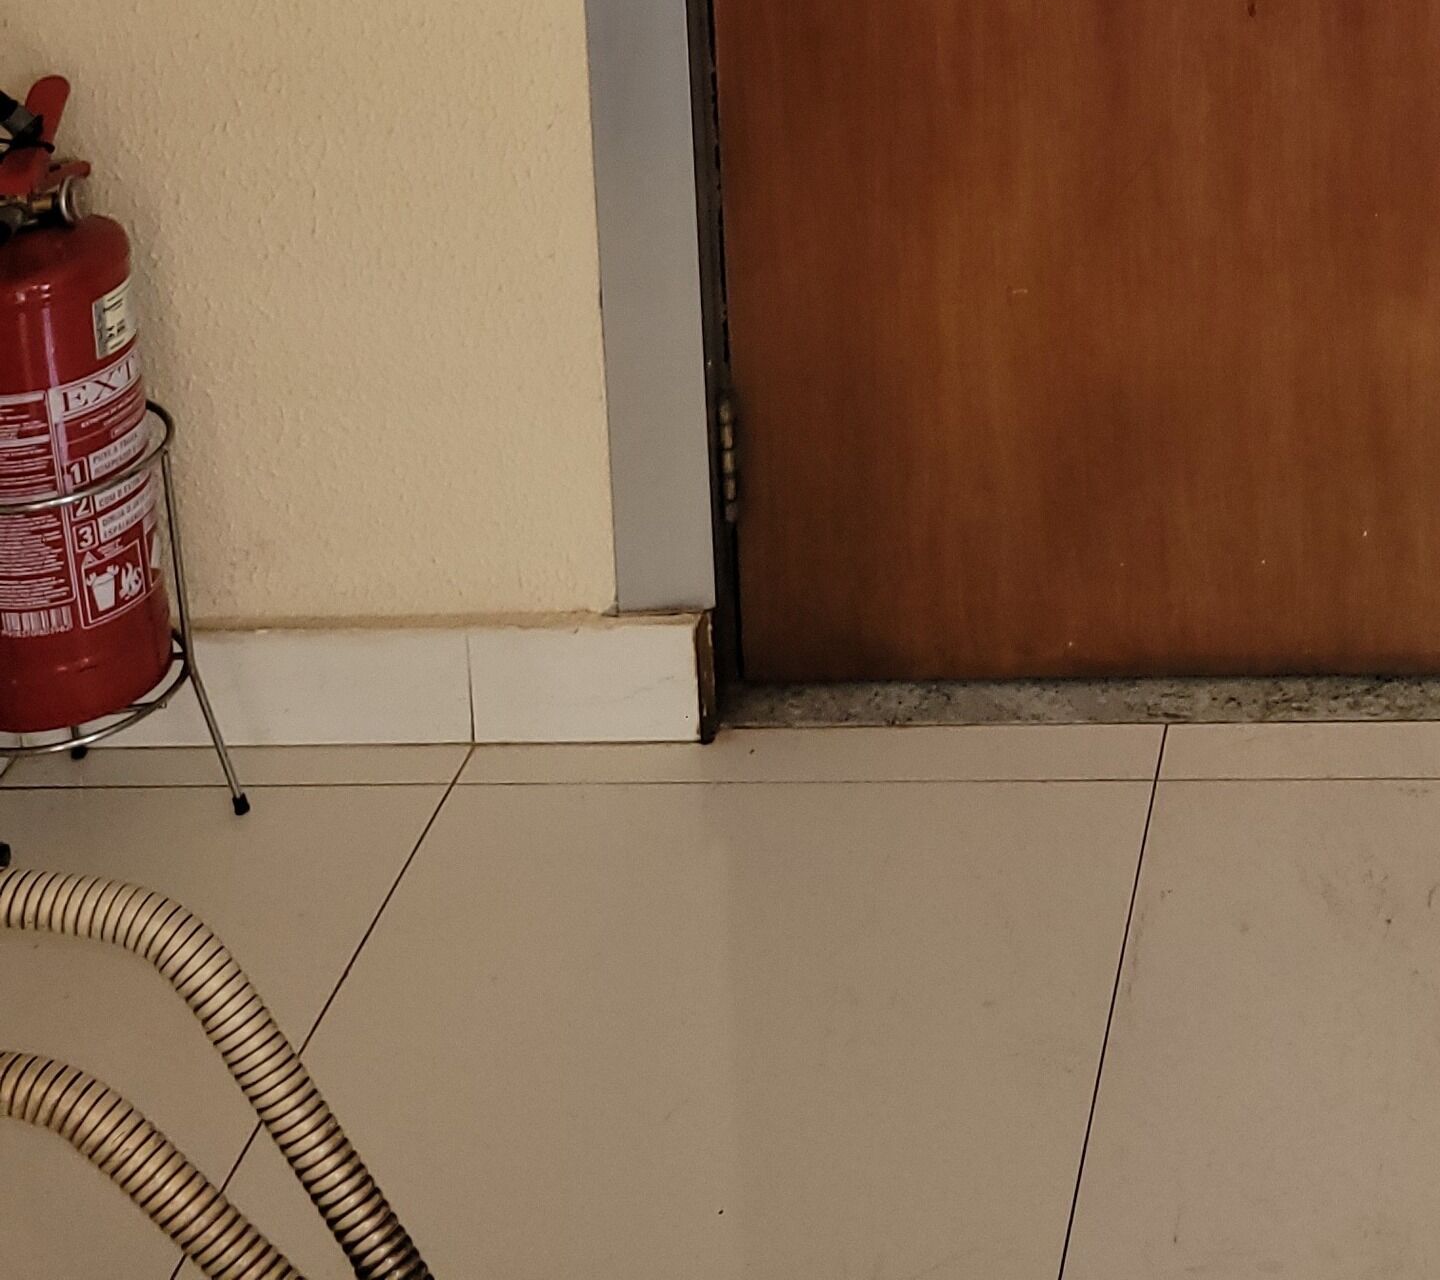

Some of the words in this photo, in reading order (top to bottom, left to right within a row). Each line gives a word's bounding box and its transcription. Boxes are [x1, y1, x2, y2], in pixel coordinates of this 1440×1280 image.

[70, 463, 81, 484] 1
[75, 497, 90, 517] 2
[79, 526, 93, 548] 3
